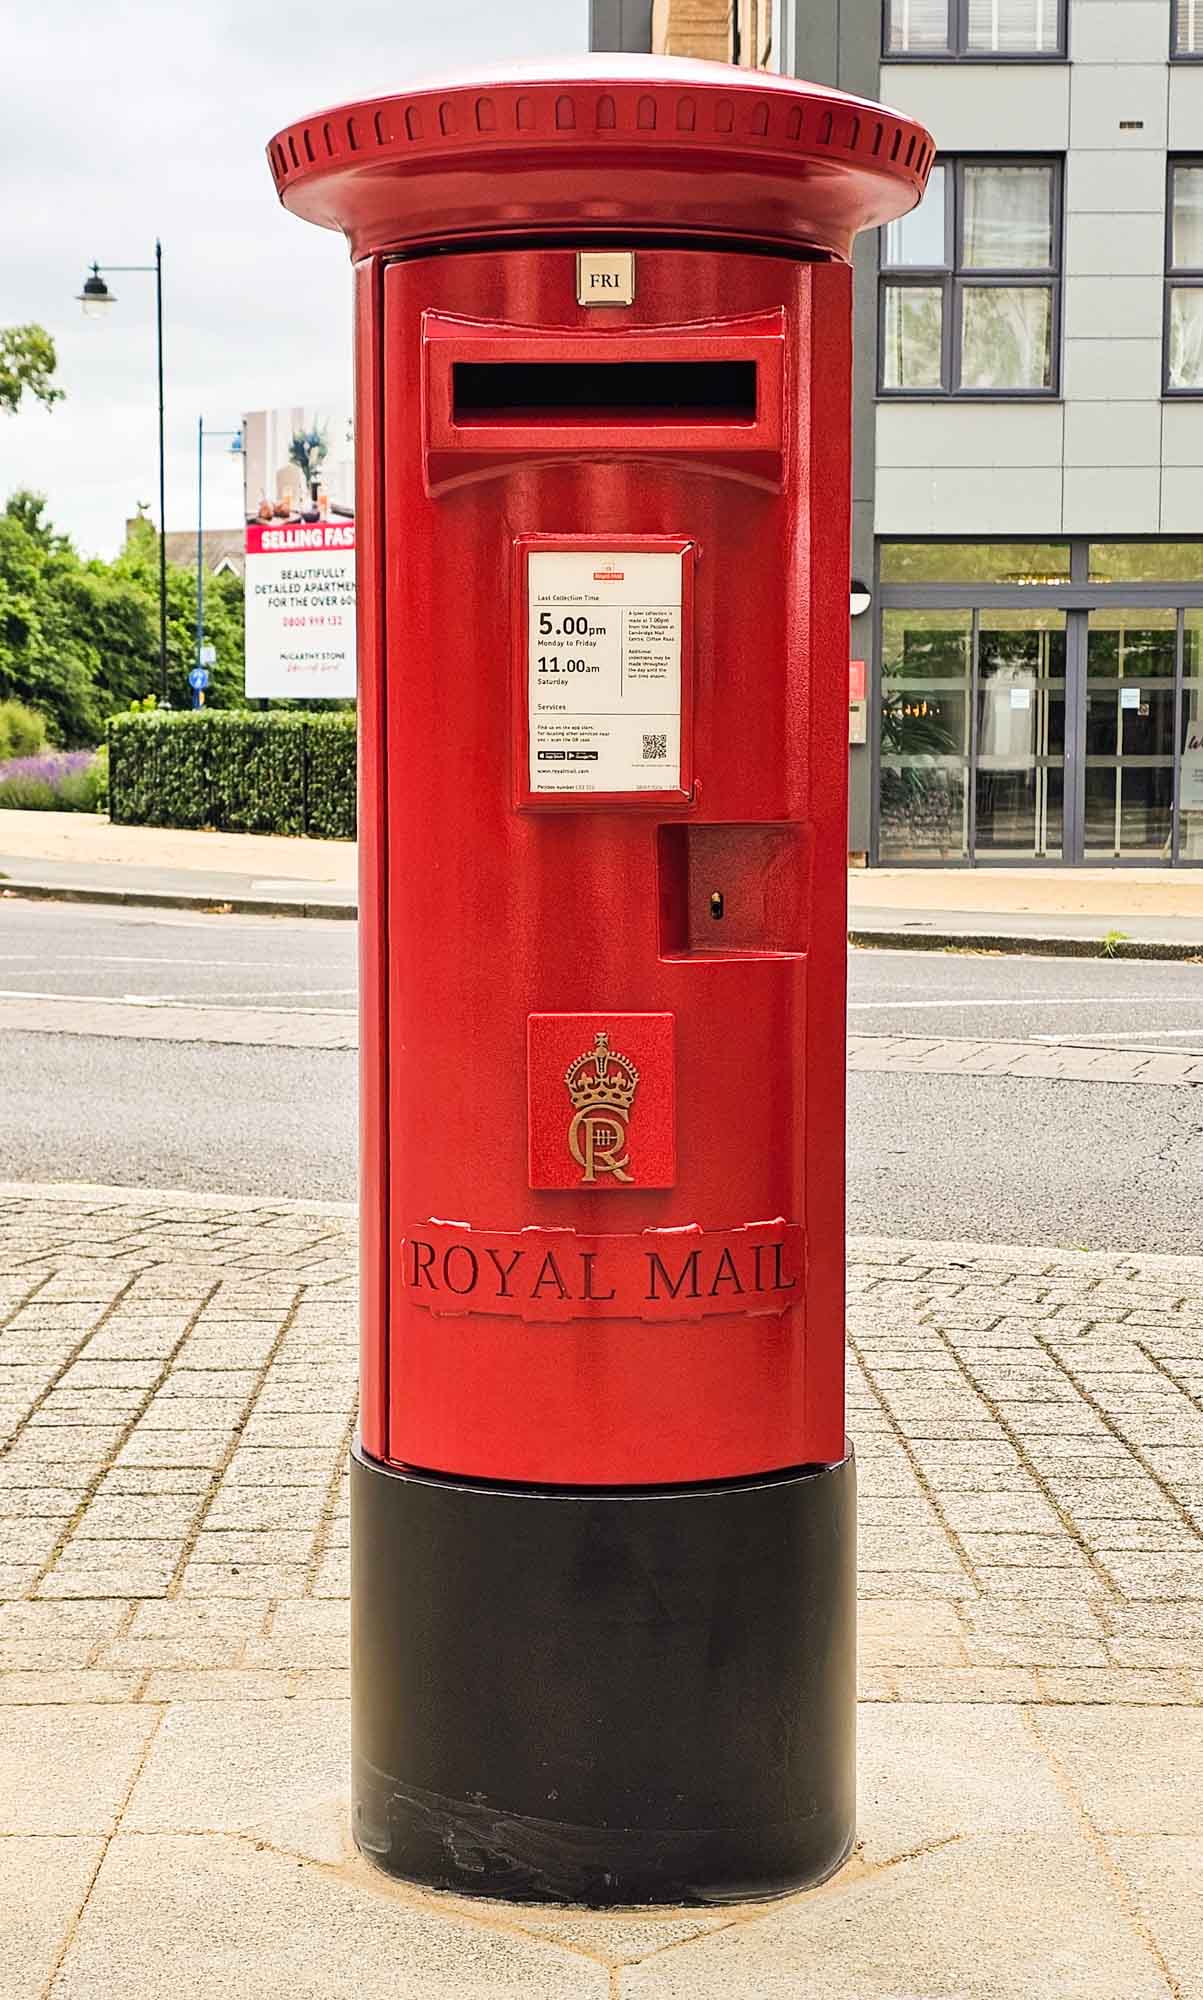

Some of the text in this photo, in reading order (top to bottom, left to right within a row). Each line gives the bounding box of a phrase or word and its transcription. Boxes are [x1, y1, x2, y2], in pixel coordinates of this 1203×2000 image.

[590, 273, 619, 288] FRI
[261, 526, 355, 550] SELLING FAS
[281, 568, 345, 580] BEAUTIFULLY
[255, 583, 300, 594] DETAILED
[268, 597, 286, 607] FOR
[290, 597, 307, 606] THE
[311, 596, 337, 606] OVER
[552, 594, 583, 602] Collection
[539, 612, 607, 637] 5.00pm
[537, 640, 564, 648] Monday
[575, 640, 597, 648] Friday
[537, 656, 600, 673] 11.00am
[537, 678, 569, 687] Saturday
[537, 703, 567, 711] Services
[409, 1240, 798, 1301] ROYAL MAIL
